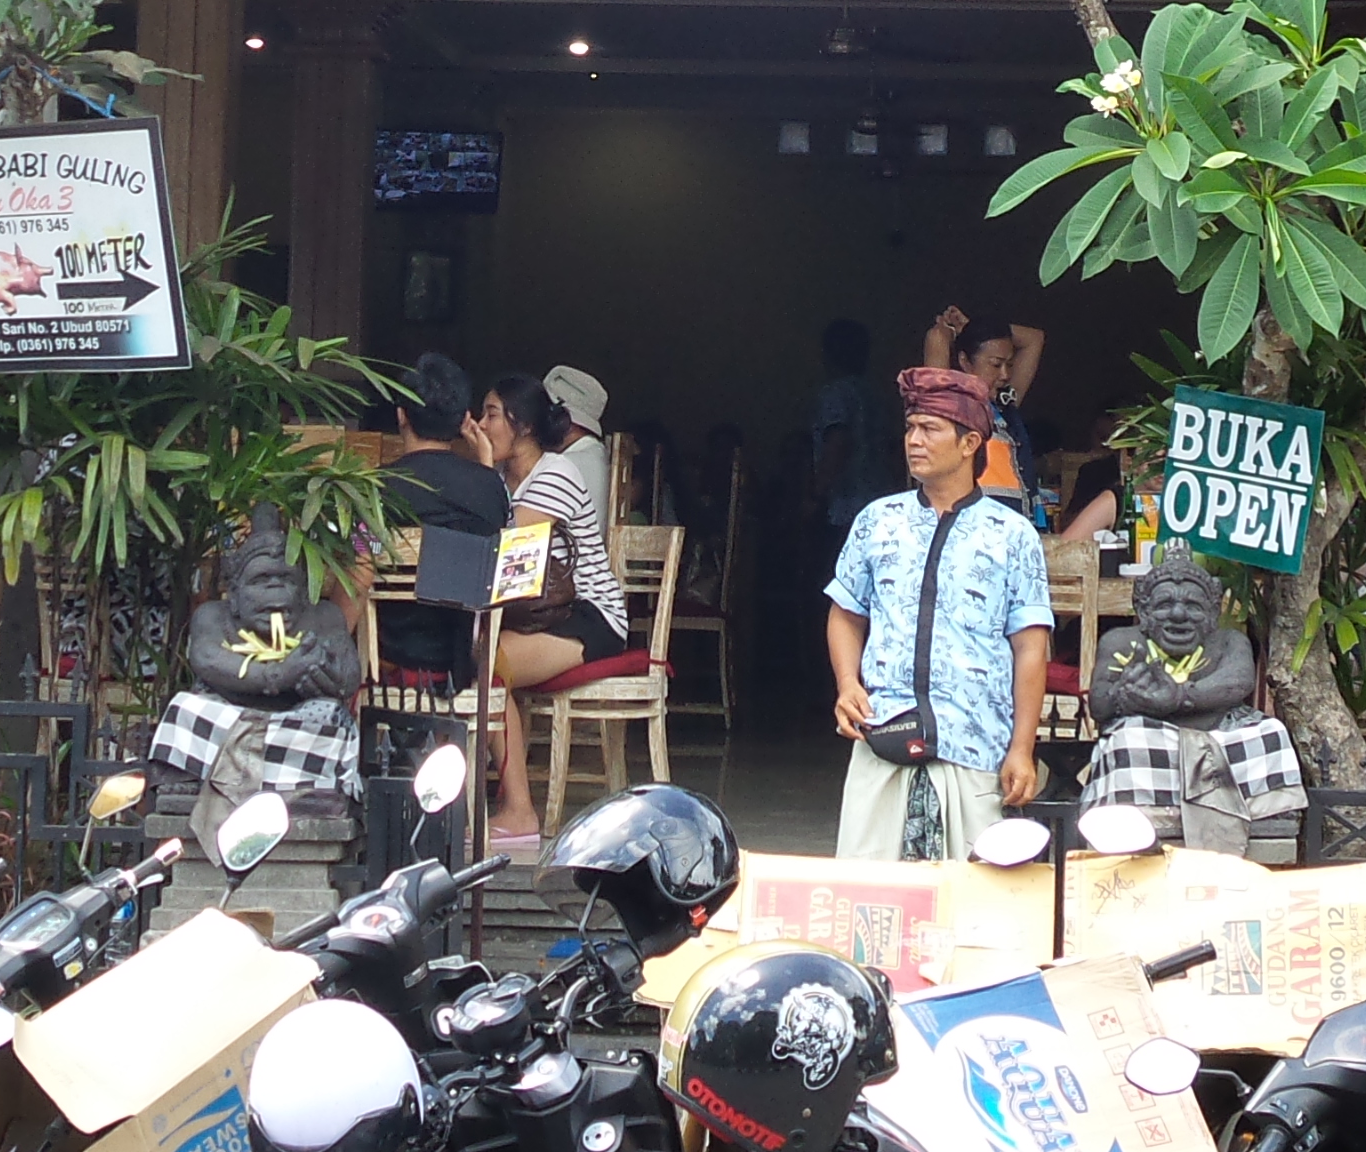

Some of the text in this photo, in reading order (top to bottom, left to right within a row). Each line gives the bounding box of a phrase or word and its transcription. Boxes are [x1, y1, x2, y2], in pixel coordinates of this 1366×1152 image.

[56, 154, 146, 195] GULING
[9, 187, 52, 212] Oka
[57, 186, 75, 212] 3
[20, 219, 44, 234] 976
[46, 217, 70, 233] 345
[54, 232, 153, 280] 100 METER
[2, 321, 26, 336] Sari
[28, 322, 49, 335] No.
[50, 322, 59, 334] 2
[61, 320, 94, 334] Ubud
[96, 319, 130, 334] 80571
[62, 301, 85, 315] 100
[17, 337, 53, 353] (0361)
[54, 337, 77, 351] 976
[79, 336, 100, 350] 345
[1168, 402, 1313, 485] BUKA
[1163, 470, 1307, 556] OPEN
[1266, 906, 1287, 1008] GUDANG
[1288, 888, 1324, 1027] GARAM
[977, 1033, 1078, 1152] AQUA
